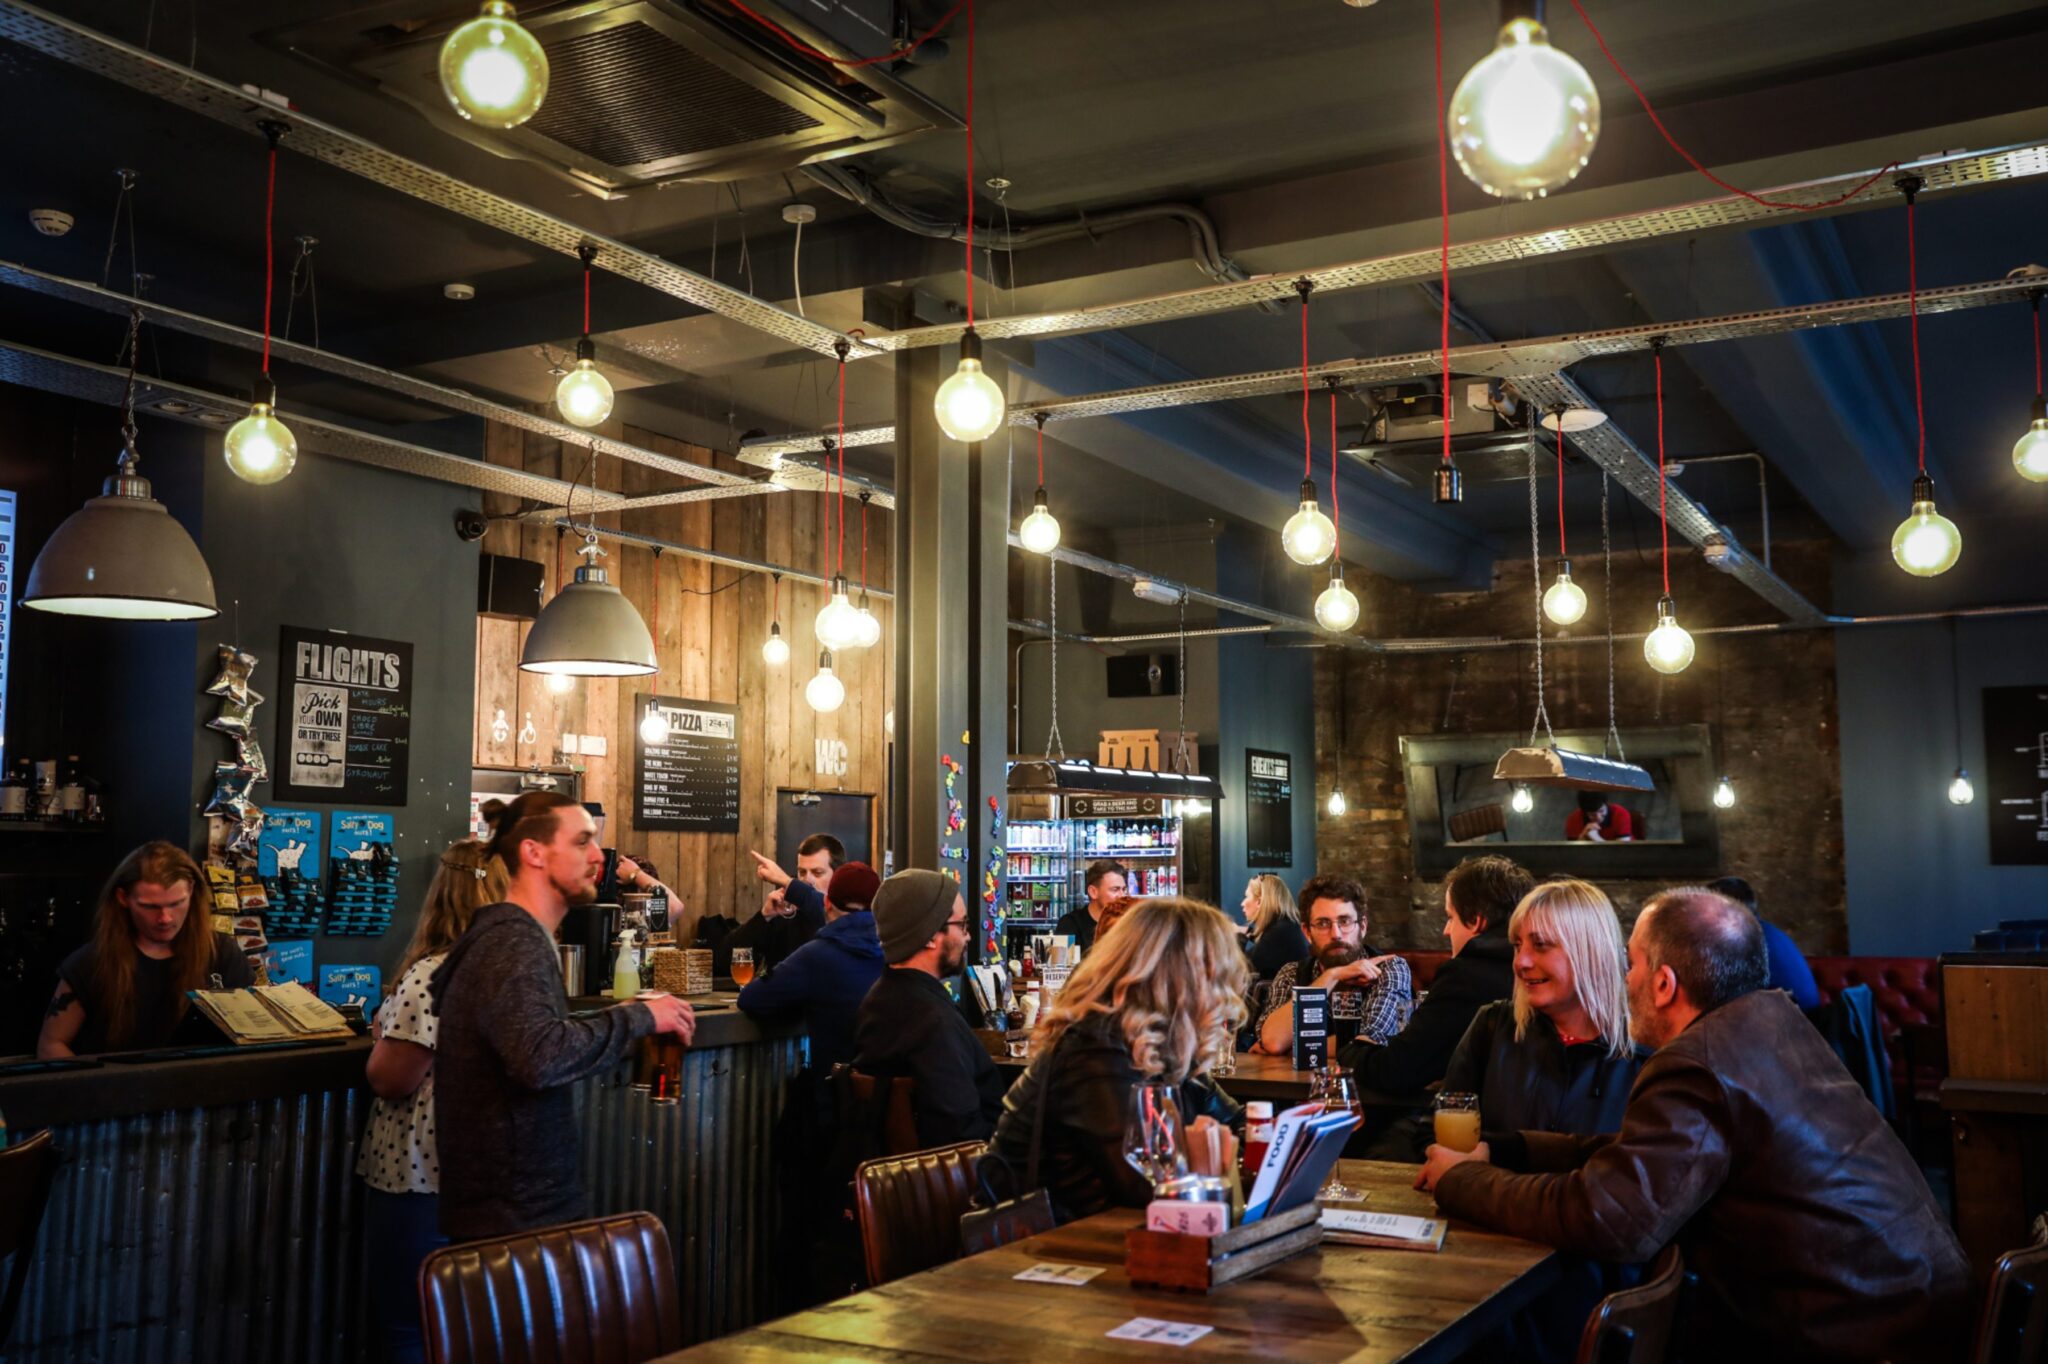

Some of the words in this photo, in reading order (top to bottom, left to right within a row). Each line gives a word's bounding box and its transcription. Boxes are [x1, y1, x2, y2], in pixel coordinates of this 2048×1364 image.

[296, 641, 400, 688] FLIGHTS
[301, 692, 341, 714] Pick
[298, 713, 315, 725] YOUR
[315, 710, 342, 727] OWN
[671, 712, 703, 732] PIZZA
[298, 729, 308, 739] OR
[309, 730, 321, 740] TRY
[321, 731, 341, 742] THESE
[815, 738, 848, 776] WC
[1251, 756, 1275, 777] EVENTS
[268, 818, 286, 828] Salty
[295, 818, 311, 828] Dog
[341, 820, 359, 831] Salty
[367, 820, 384, 830] Dog
[328, 973, 346, 983] Salty
[354, 973, 371, 983] Dog
[1266, 1123, 1289, 1168] FOOD
